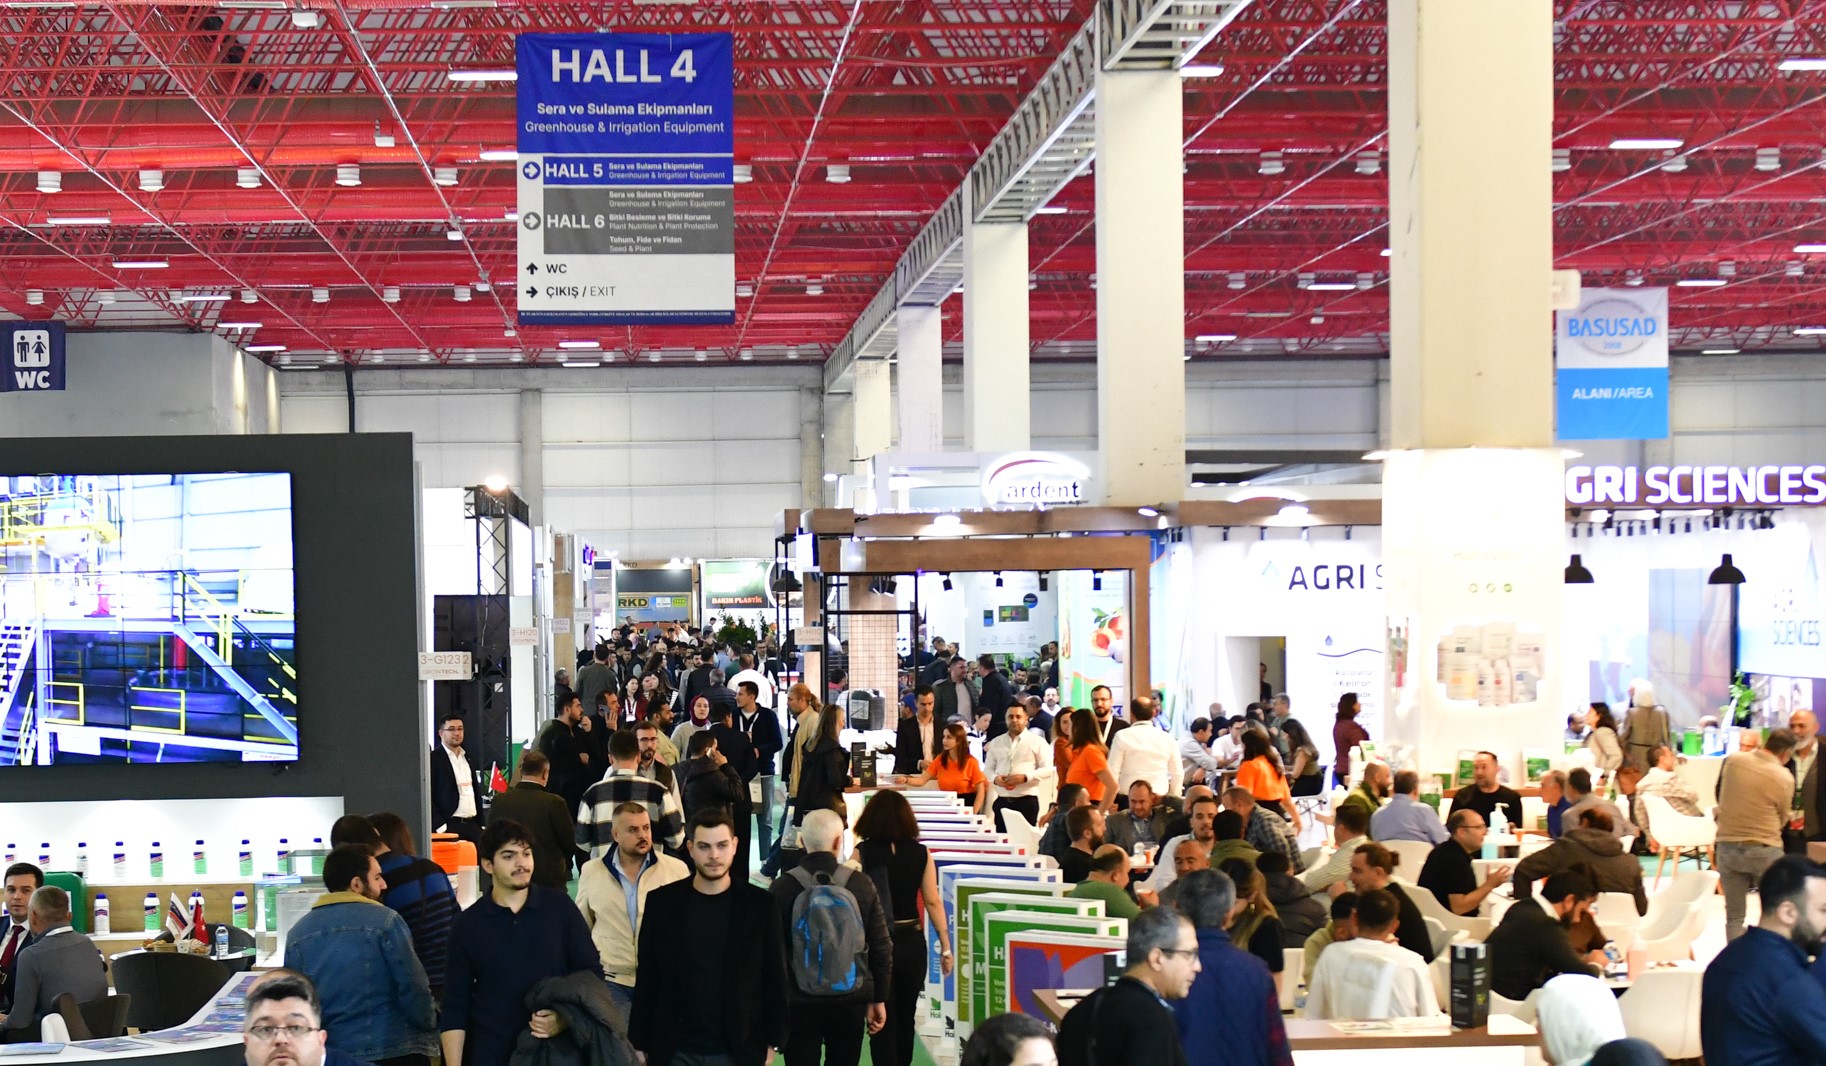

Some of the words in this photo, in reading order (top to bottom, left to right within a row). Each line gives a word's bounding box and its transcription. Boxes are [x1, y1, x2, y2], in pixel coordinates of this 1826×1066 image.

[552, 49, 662, 83] HALL
[670, 49, 697, 83] 4
[537, 103, 566, 115] Sera
[569, 106, 584, 115] ve
[587, 103, 635, 115] Sulama
[638, 103, 713, 118] Ekipmanları
[525, 121, 595, 133] Greenhouse
[598, 121, 606, 133] &
[609, 121, 661, 135] Irrigation
[664, 121, 725, 135] Equipment
[545, 163, 590, 178] HALL
[593, 163, 604, 178] 5
[663, 163, 704, 171] Ekipmanları
[658, 172, 688, 180] Irrigation
[690, 172, 725, 180] Equipment
[663, 191, 704, 199] Ekipmanları
[658, 200, 688, 208] Irrigation
[690, 200, 725, 208] Equipment
[547, 214, 590, 229] HALL
[594, 214, 605, 229] 6
[546, 264, 567, 274] WC
[546, 286, 579, 299] ÇIKIŞ
[582, 286, 587, 297] /
[590, 286, 616, 297] EXIT
[1568, 318, 1657, 337] BASUSAD
[15, 371, 50, 388] WC
[1007, 481, 1080, 498] ardent
[1644, 466, 1826, 504] SCIENCES
[1288, 564, 1365, 590] AGRI
[618, 599, 648, 607] RKD
